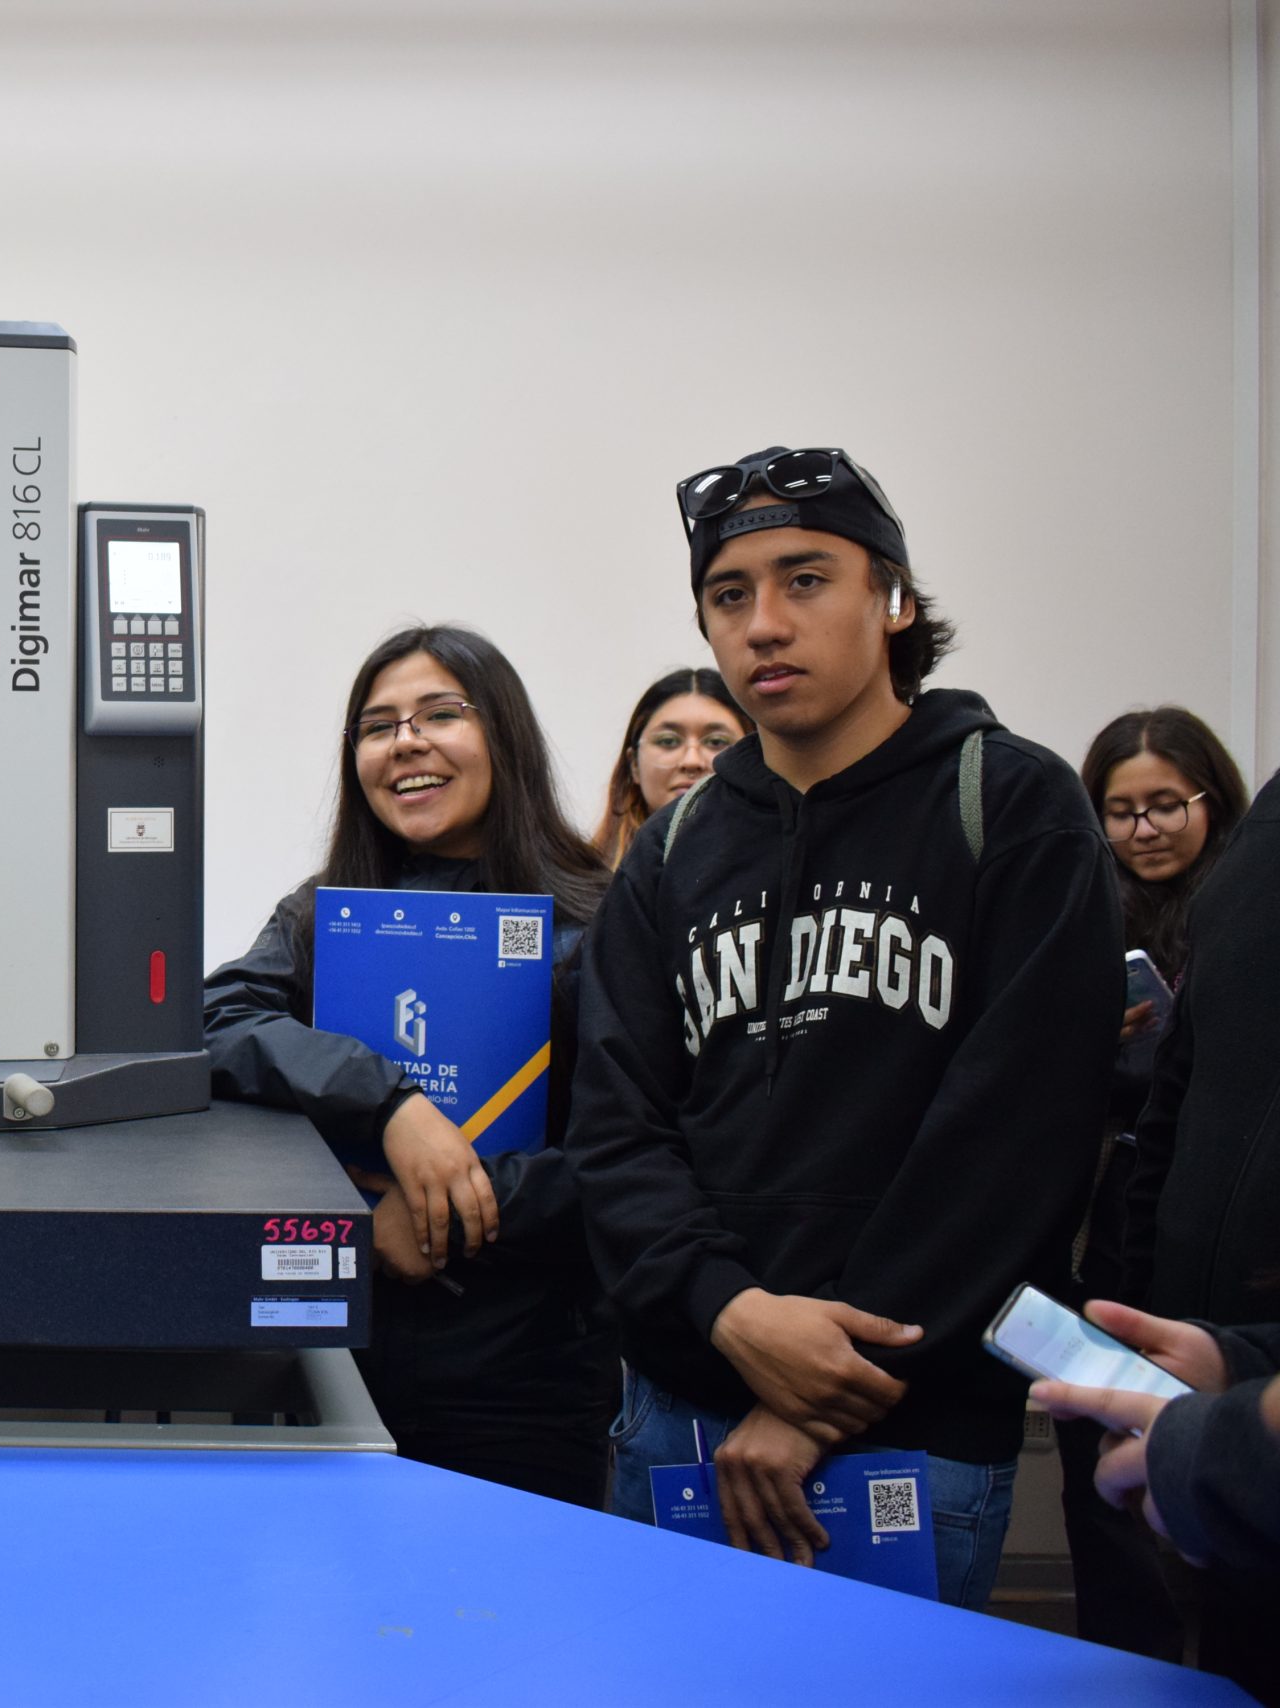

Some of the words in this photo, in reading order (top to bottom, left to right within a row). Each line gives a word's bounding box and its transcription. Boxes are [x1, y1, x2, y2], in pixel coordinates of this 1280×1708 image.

[12, 437, 42, 476] CL
[12, 485, 42, 541] 816
[11, 552, 49, 692] Digimar
[688, 880, 921, 943] CALIORNIA
[783, 907, 955, 1031] DIEGO
[806, 1007, 829, 1021] COAST
[438, 1064, 458, 1077] DE
[263, 1218, 353, 1244] 55697
